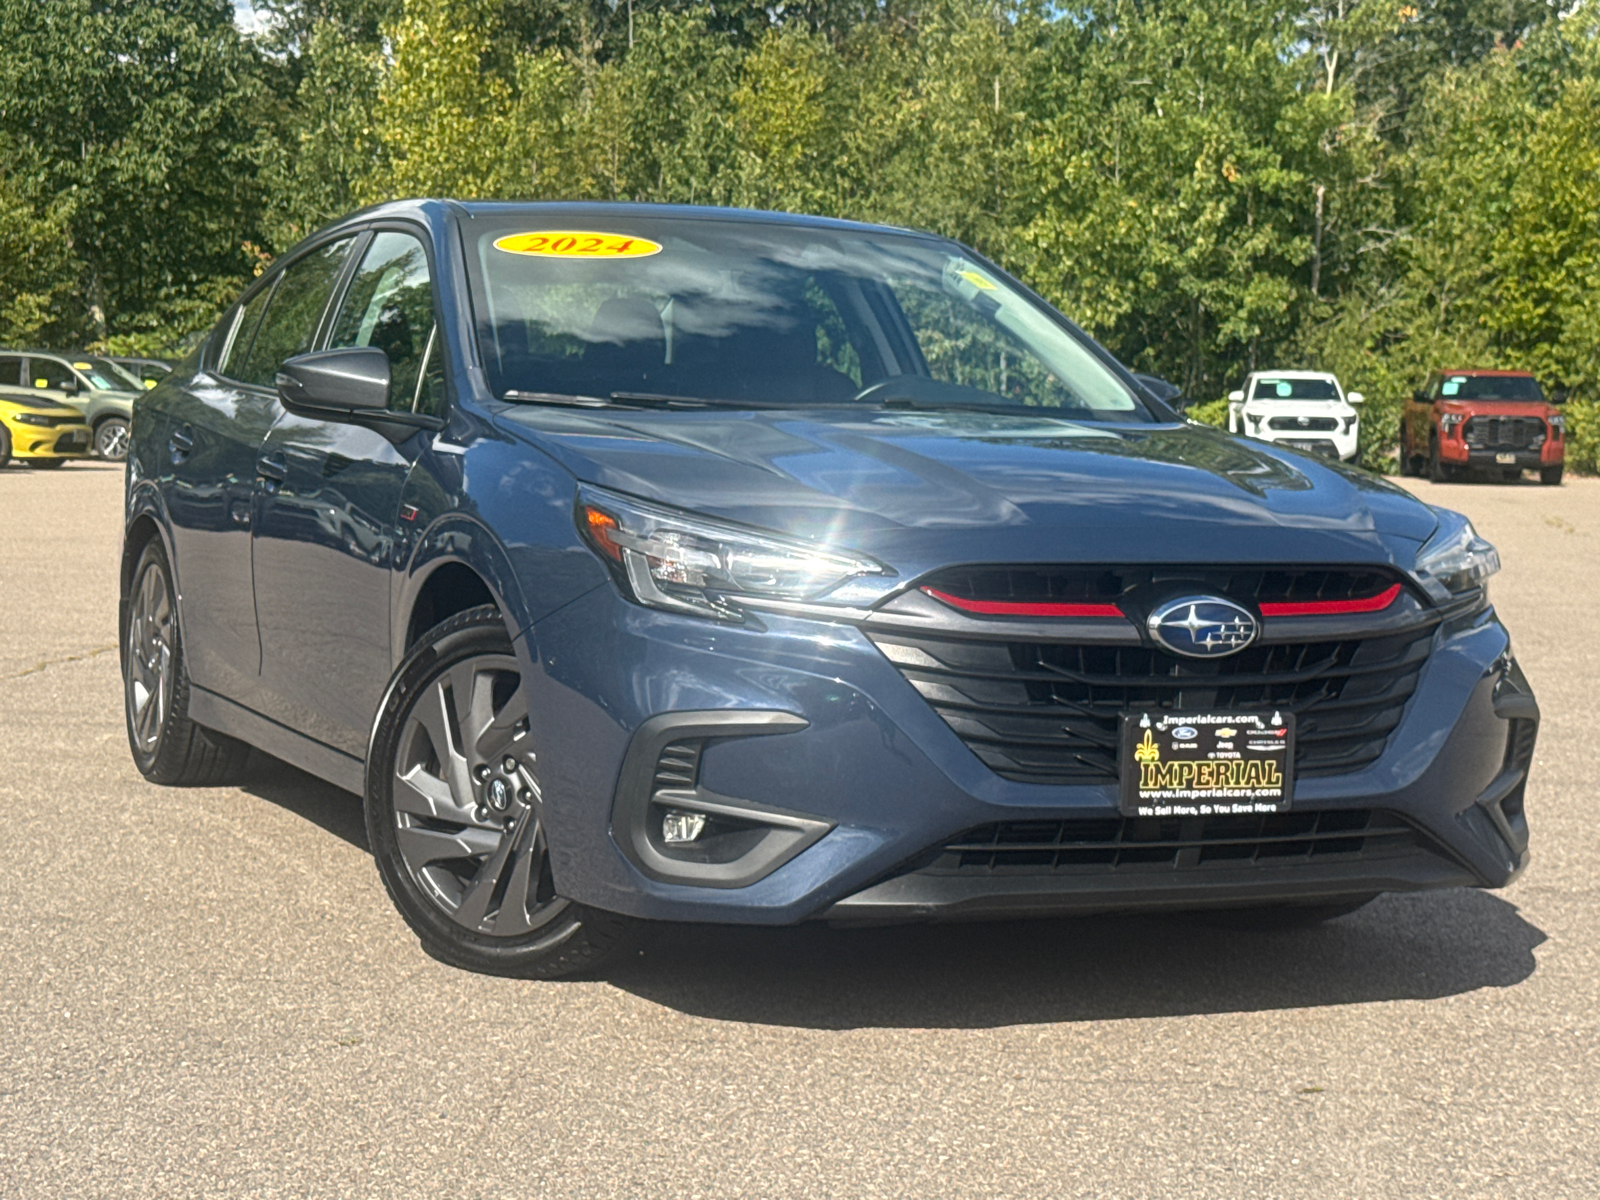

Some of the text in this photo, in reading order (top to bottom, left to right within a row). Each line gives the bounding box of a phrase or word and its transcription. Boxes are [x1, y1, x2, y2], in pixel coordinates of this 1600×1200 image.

[522, 237, 635, 253] 2024
[1163, 714, 1259, 726] Imperialcars.com
[1139, 760, 1282, 789] IMPERIAL
[1139, 788, 1281, 799] www.imperialcars.com
[1138, 803, 1277, 816] We Sell More, So You Save More
